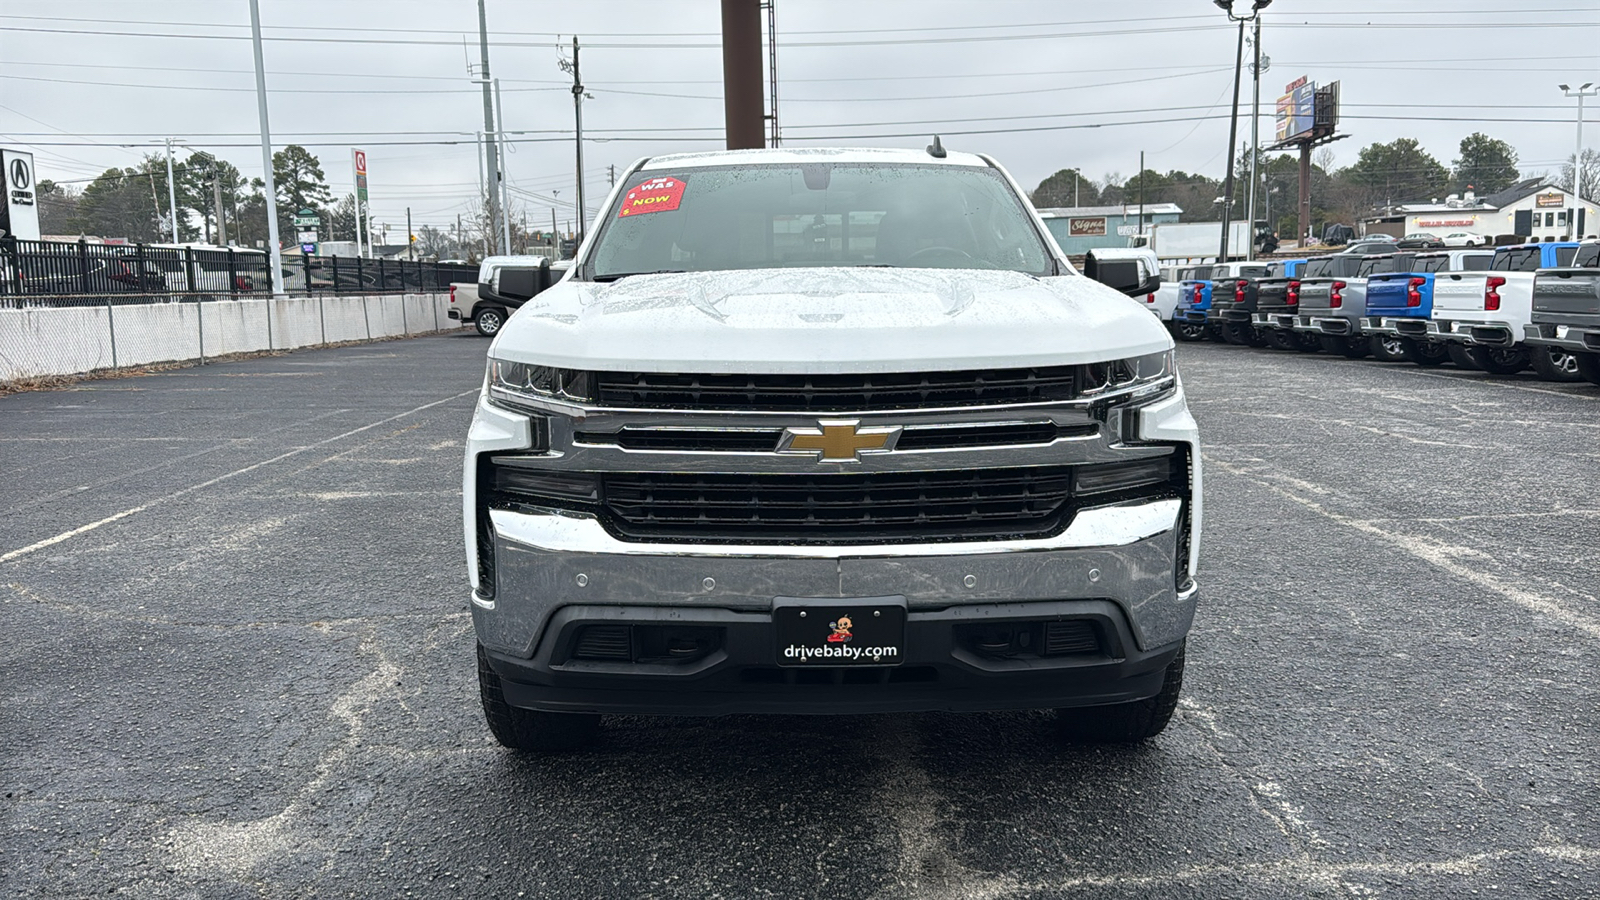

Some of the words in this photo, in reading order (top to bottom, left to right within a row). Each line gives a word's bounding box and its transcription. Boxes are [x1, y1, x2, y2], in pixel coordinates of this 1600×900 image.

[641, 181, 674, 190] WAS
[633, 195, 670, 206] NOW
[784, 644, 897, 660] drivebaby.com
